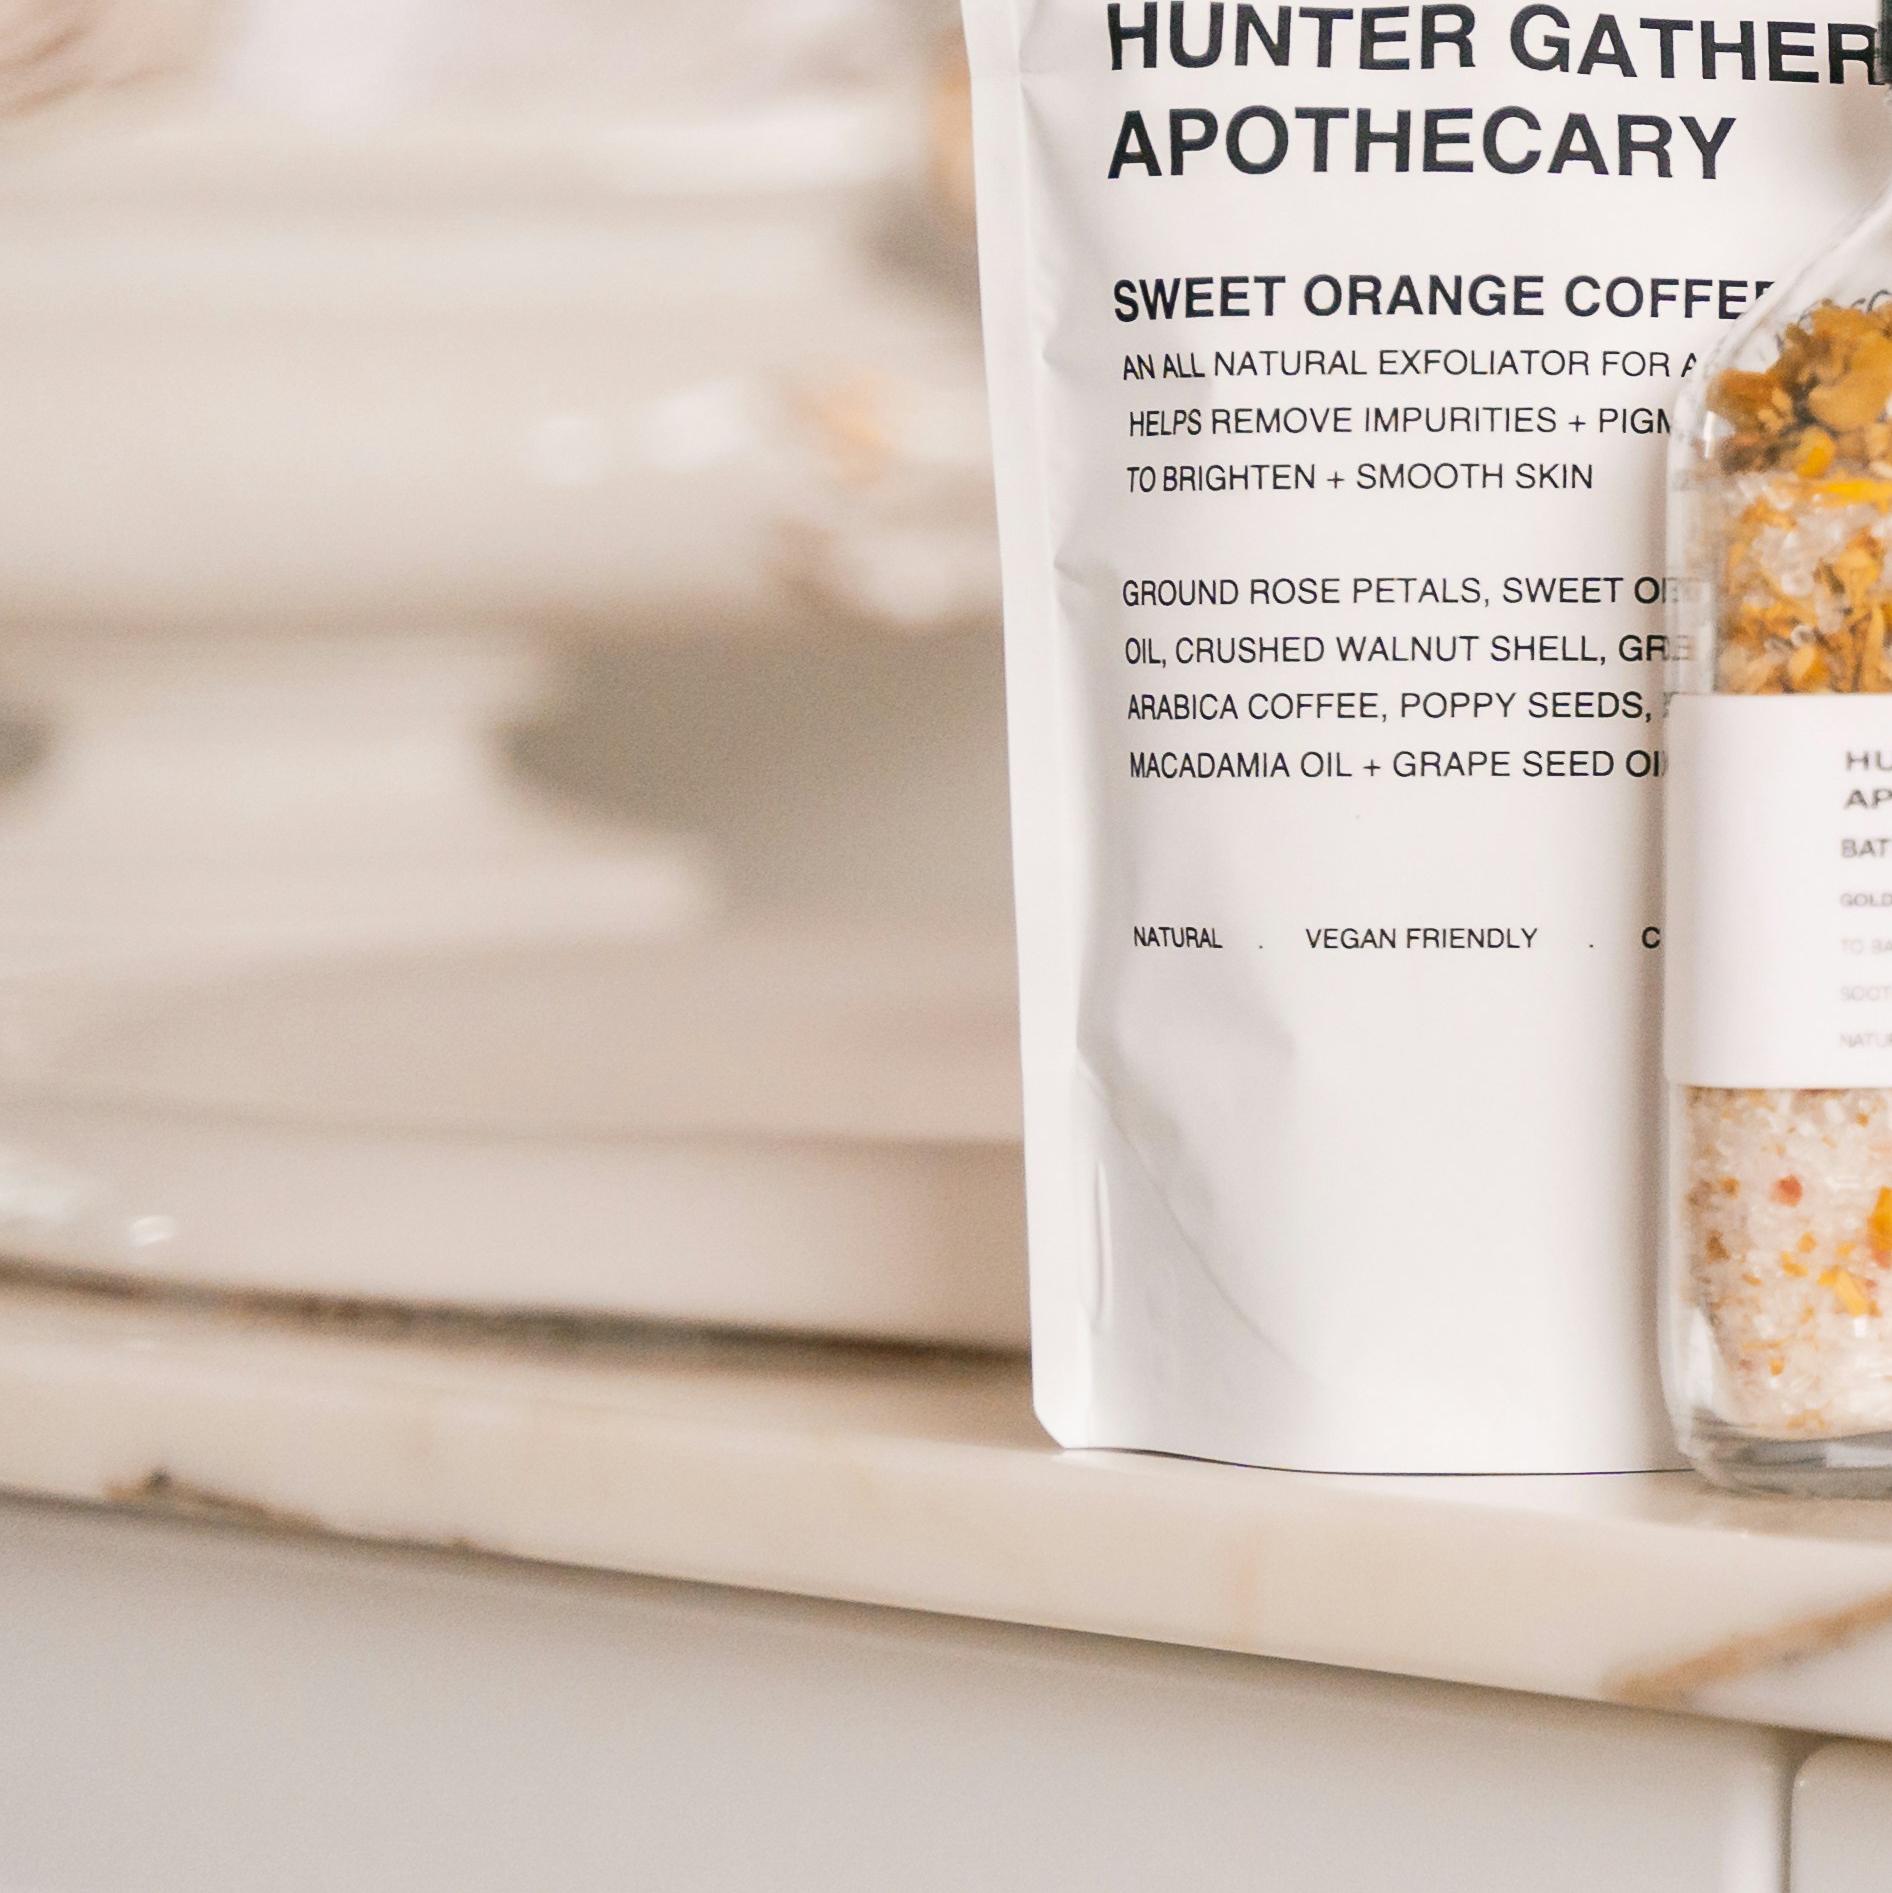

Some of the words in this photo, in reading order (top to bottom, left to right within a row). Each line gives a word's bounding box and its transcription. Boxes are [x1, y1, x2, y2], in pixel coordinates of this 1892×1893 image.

[1107, 0, 1476, 71] HUNTER
[1107, 105, 1737, 180] APOTHECARY
[1113, 275, 1286, 323] SWEET
[1303, 274, 1545, 317] ORANGE
[1123, 353, 1156, 381] AN
[1162, 352, 1206, 379] ALL
[1214, 349, 1368, 377] NATURAL
[1379, 349, 1589, 376] EXFOLIATOR
[1602, 350, 1670, 378] FOR
[1129, 408, 1202, 437] HELPS
[1211, 407, 1353, 435] REMOVE
[1365, 406, 1557, 433] IMPURITIES
[1568, 415, 1587, 433] +
[1126, 465, 1157, 493] TO
[1162, 463, 1315, 492] BRIGHTEN
[1326, 471, 1345, 490] +
[1356, 462, 1503, 490] SMOOTH
[1515, 462, 1593, 489] SKIN
[1122, 579, 1239, 607] GROUND
[1250, 577, 1341, 605] ROSE
[1353, 577, 1489, 608] PETALS,
[1502, 576, 1625, 604] SWEET
[1125, 637, 1167, 669] OIL,
[1175, 636, 1325, 665] CRUSHED
[1335, 635, 1480, 662] WALNUT
[1490, 635, 1606, 666] SHELL,
[1127, 693, 1239, 721] ARABICA
[1248, 692, 1387, 723] COFFEE,
[1401, 691, 1517, 719] POPPY
[1528, 692, 1651, 723] SEEDS,
[1129, 751, 1291, 779] MACADAMIA
[1300, 751, 1353, 778] OIL
[1363, 759, 1381, 777] +
[1393, 750, 1511, 778] GRAPE
[1522, 750, 1615, 778] SEED
[1133, 925, 1224, 949] NATURAL
[1305, 927, 1396, 950] VEGAN
[1406, 927, 1538, 949] FRIENDLY
